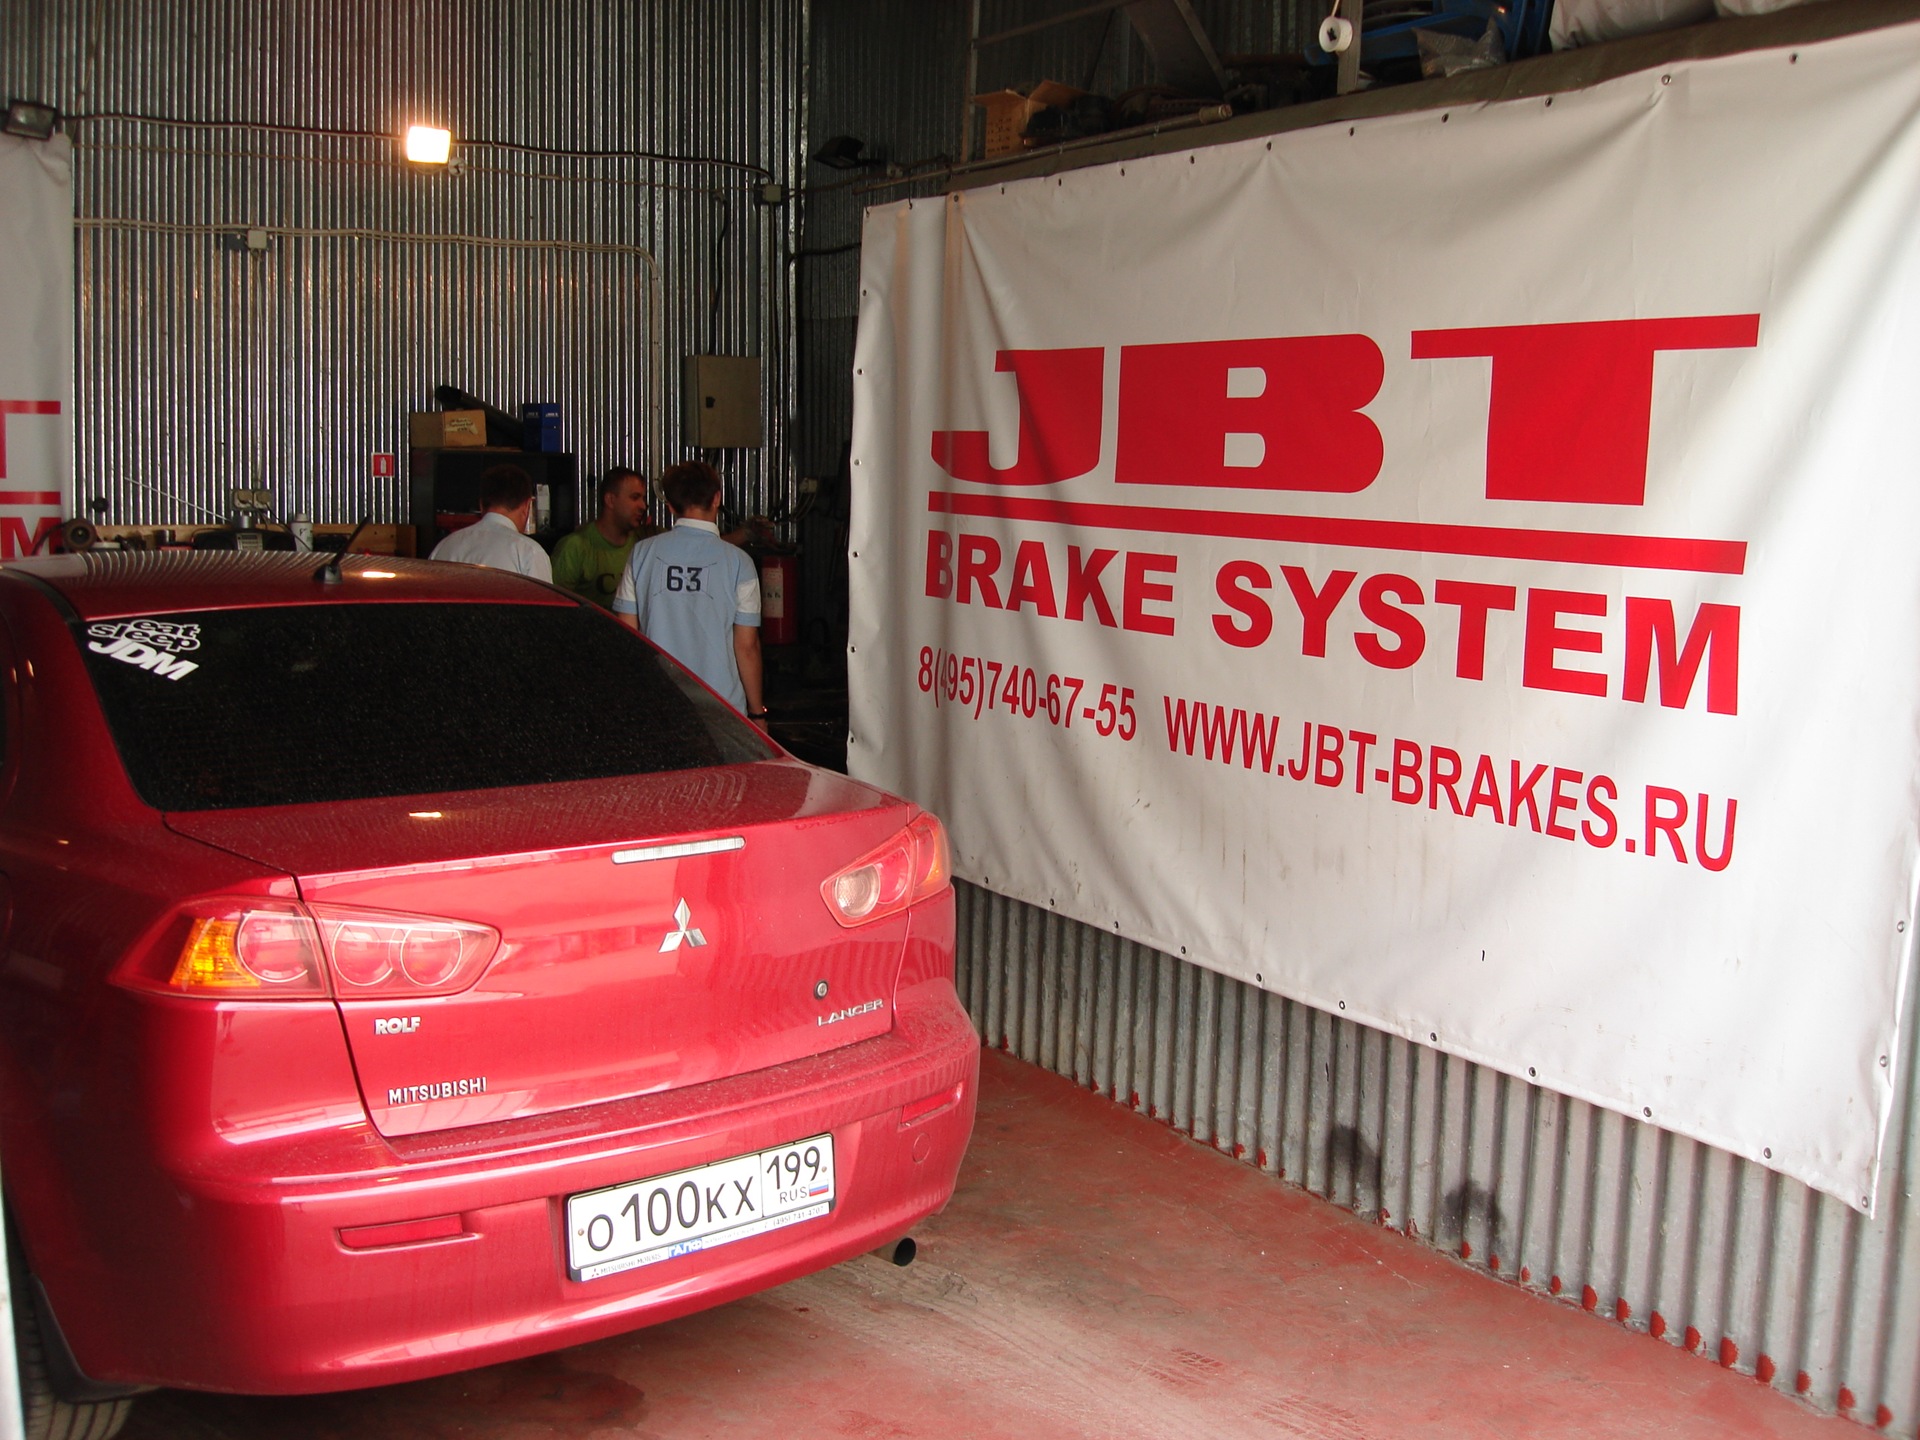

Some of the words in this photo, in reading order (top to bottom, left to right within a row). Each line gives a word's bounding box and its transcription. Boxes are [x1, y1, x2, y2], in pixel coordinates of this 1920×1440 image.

[930, 313, 1758, 505] JBT
[666, 565, 703, 592] 63
[131, 619, 201, 639] eat
[925, 529, 1178, 637] BRAKE
[1211, 559, 1741, 716] SYSTEM
[88, 623, 201, 652] sleep
[88, 640, 200, 681] JDM
[918, 645, 1137, 741] 8(495)740-67-55
[1163, 695, 1738, 872] WWW.JBT-BRAKES.RU
[374, 1016, 421, 1035] ROLF
[817, 998, 884, 1027] LANCER
[387, 1076, 487, 1105] MITSUBISHI
[766, 1145, 821, 1190] 199
[779, 1189, 808, 1204] RUS
